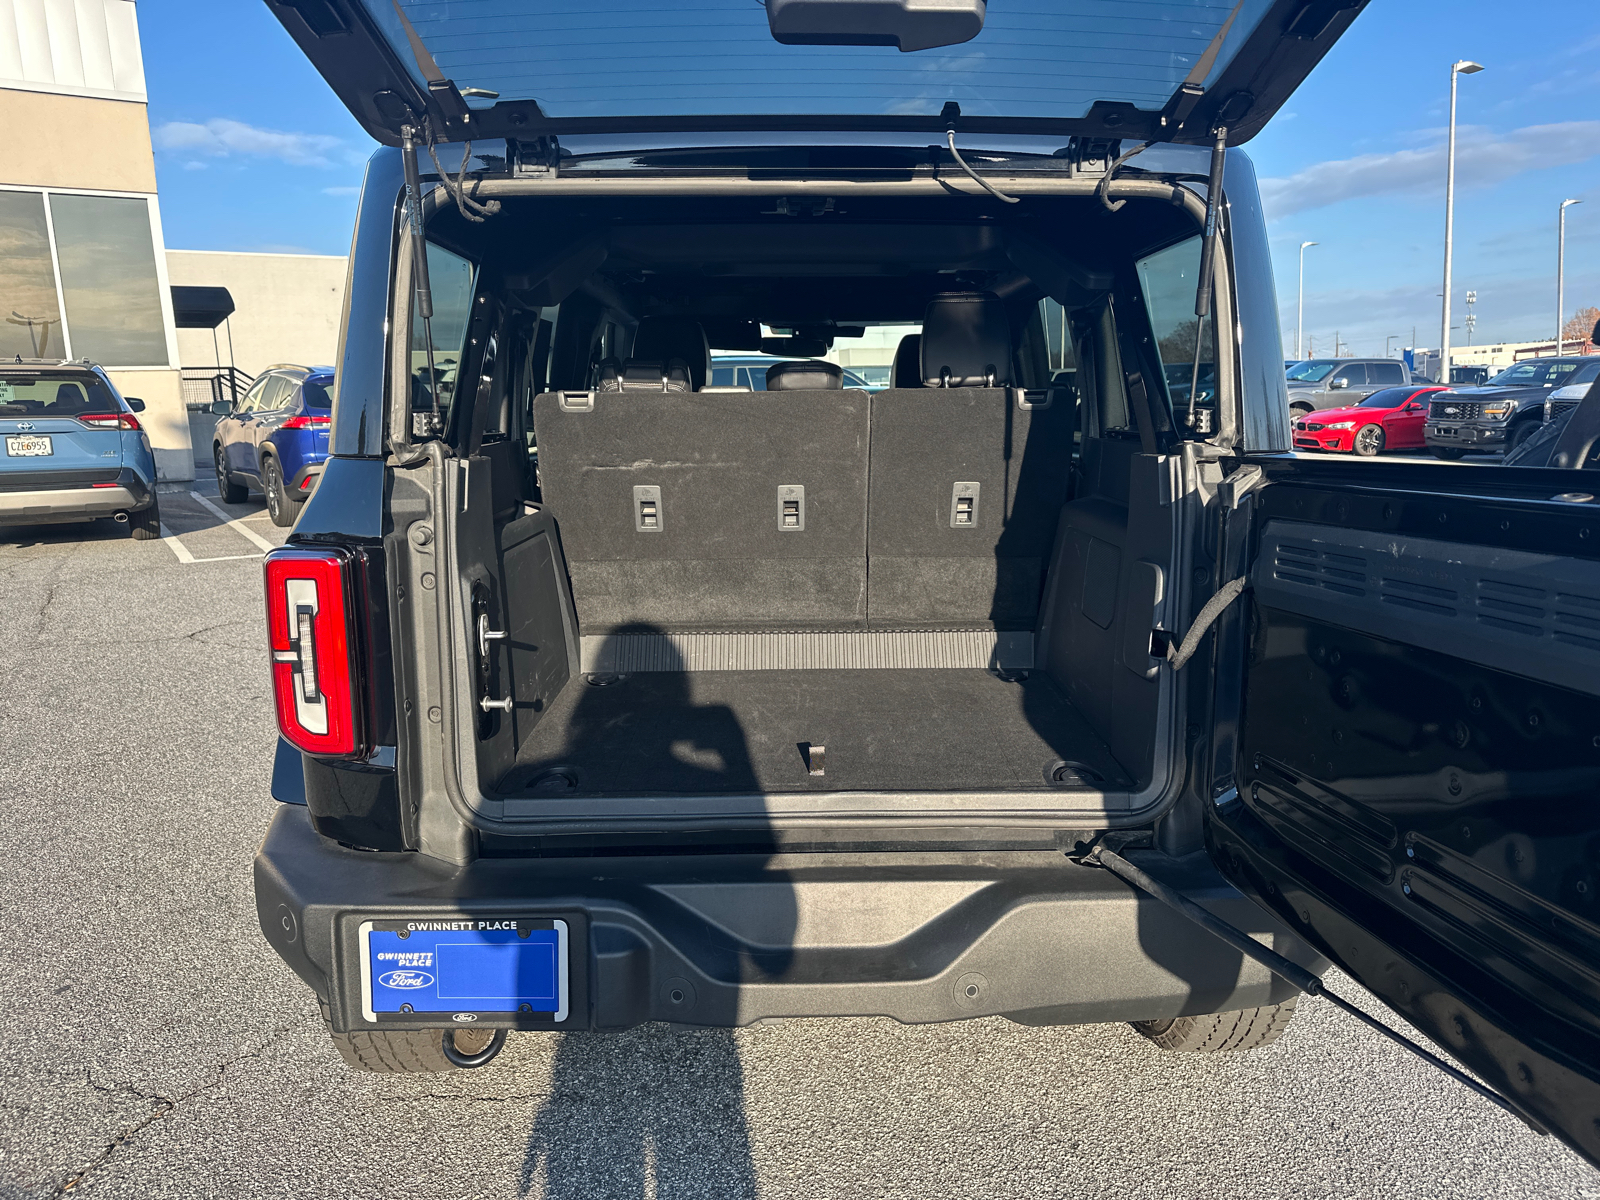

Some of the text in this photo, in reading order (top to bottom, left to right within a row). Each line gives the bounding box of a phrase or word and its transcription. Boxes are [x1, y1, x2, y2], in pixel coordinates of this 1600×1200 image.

[11, 441, 47, 451] CZE6955
[407, 921, 517, 931] GWINNETT PLACE
[377, 952, 433, 960] GWINNETT
[398, 959, 433, 967] PLACE
[389, 972, 424, 986] Ford
